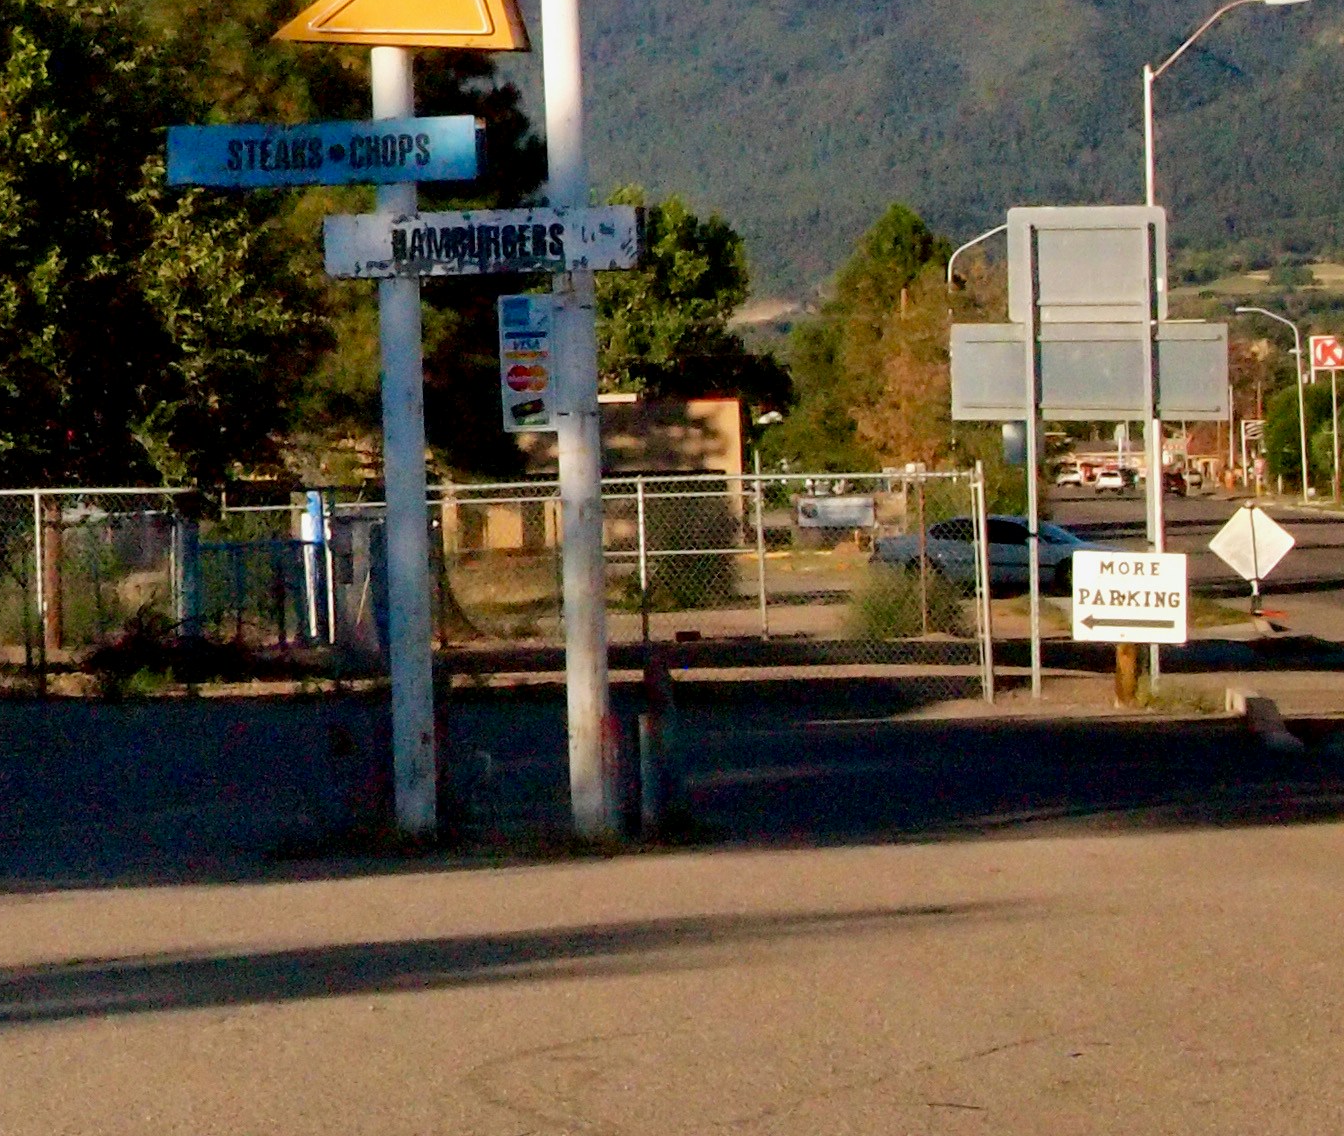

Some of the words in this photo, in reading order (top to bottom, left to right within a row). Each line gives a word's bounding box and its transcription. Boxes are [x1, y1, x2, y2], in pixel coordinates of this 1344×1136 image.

[226, 133, 324, 172] STEAKS
[349, 132, 431, 167] CHOPS
[391, 222, 565, 264] HAMBURGERS
[1099, 560, 1161, 577] MORE
[1077, 587, 1181, 609] PARKING
